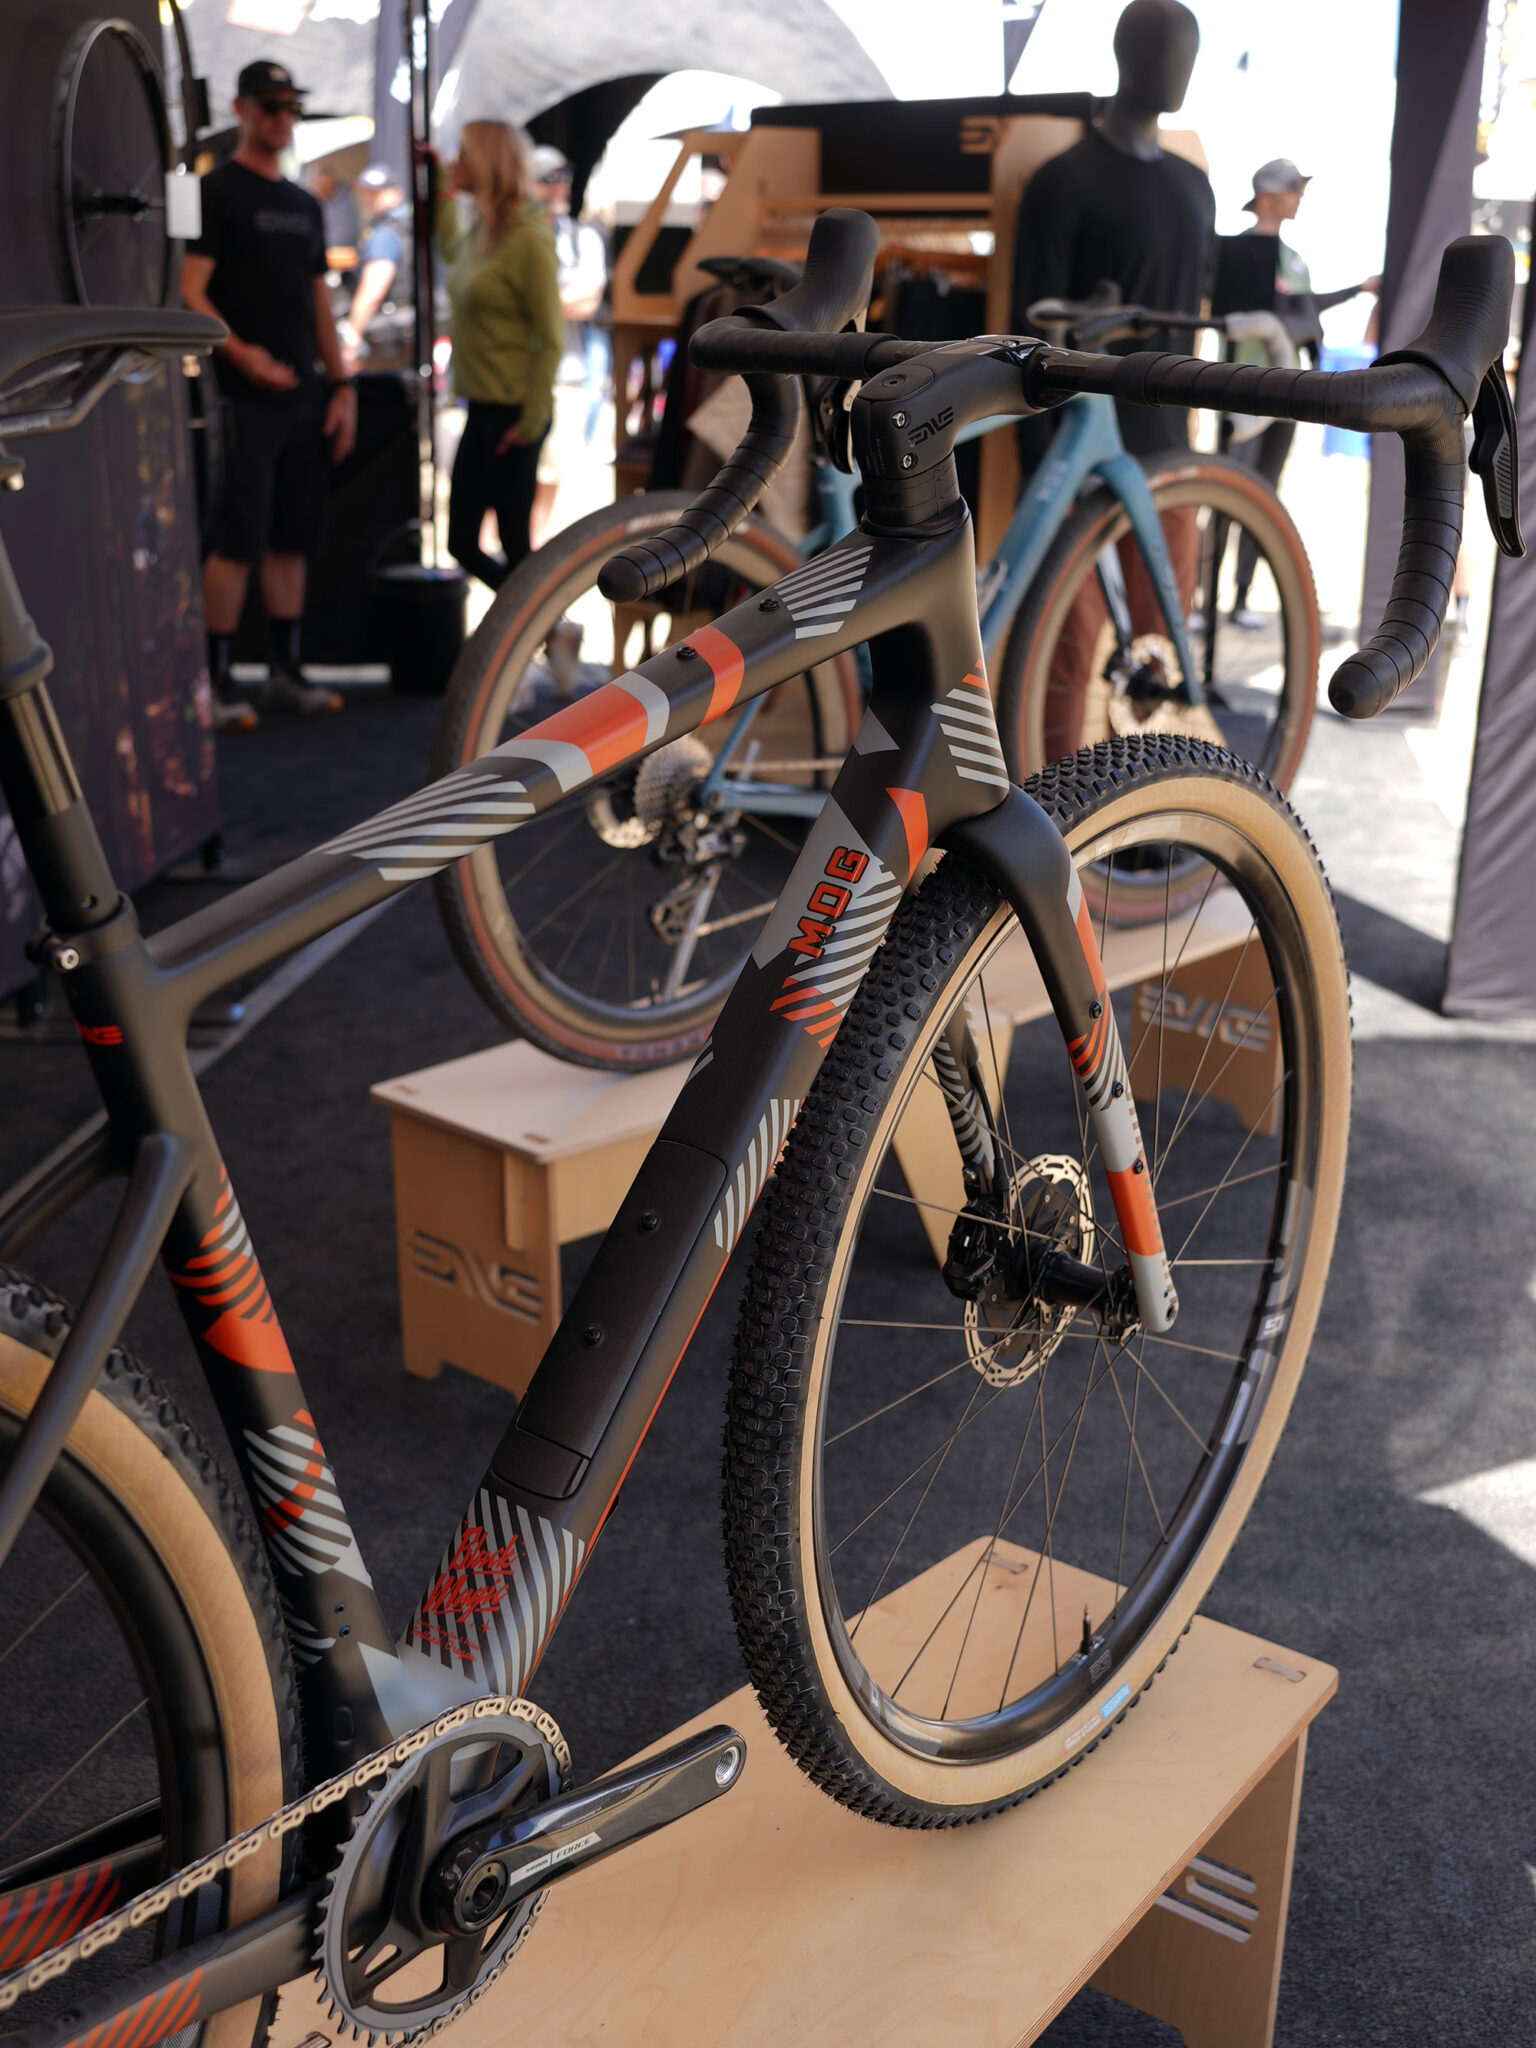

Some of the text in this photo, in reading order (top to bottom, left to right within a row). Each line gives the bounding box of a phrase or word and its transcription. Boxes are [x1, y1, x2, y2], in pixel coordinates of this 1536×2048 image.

[787, 845, 870, 960] MOG
[448, 1525, 519, 1572] Black
[421, 1572, 510, 1624] Magic
[556, 1837, 592, 1859] FORCE
